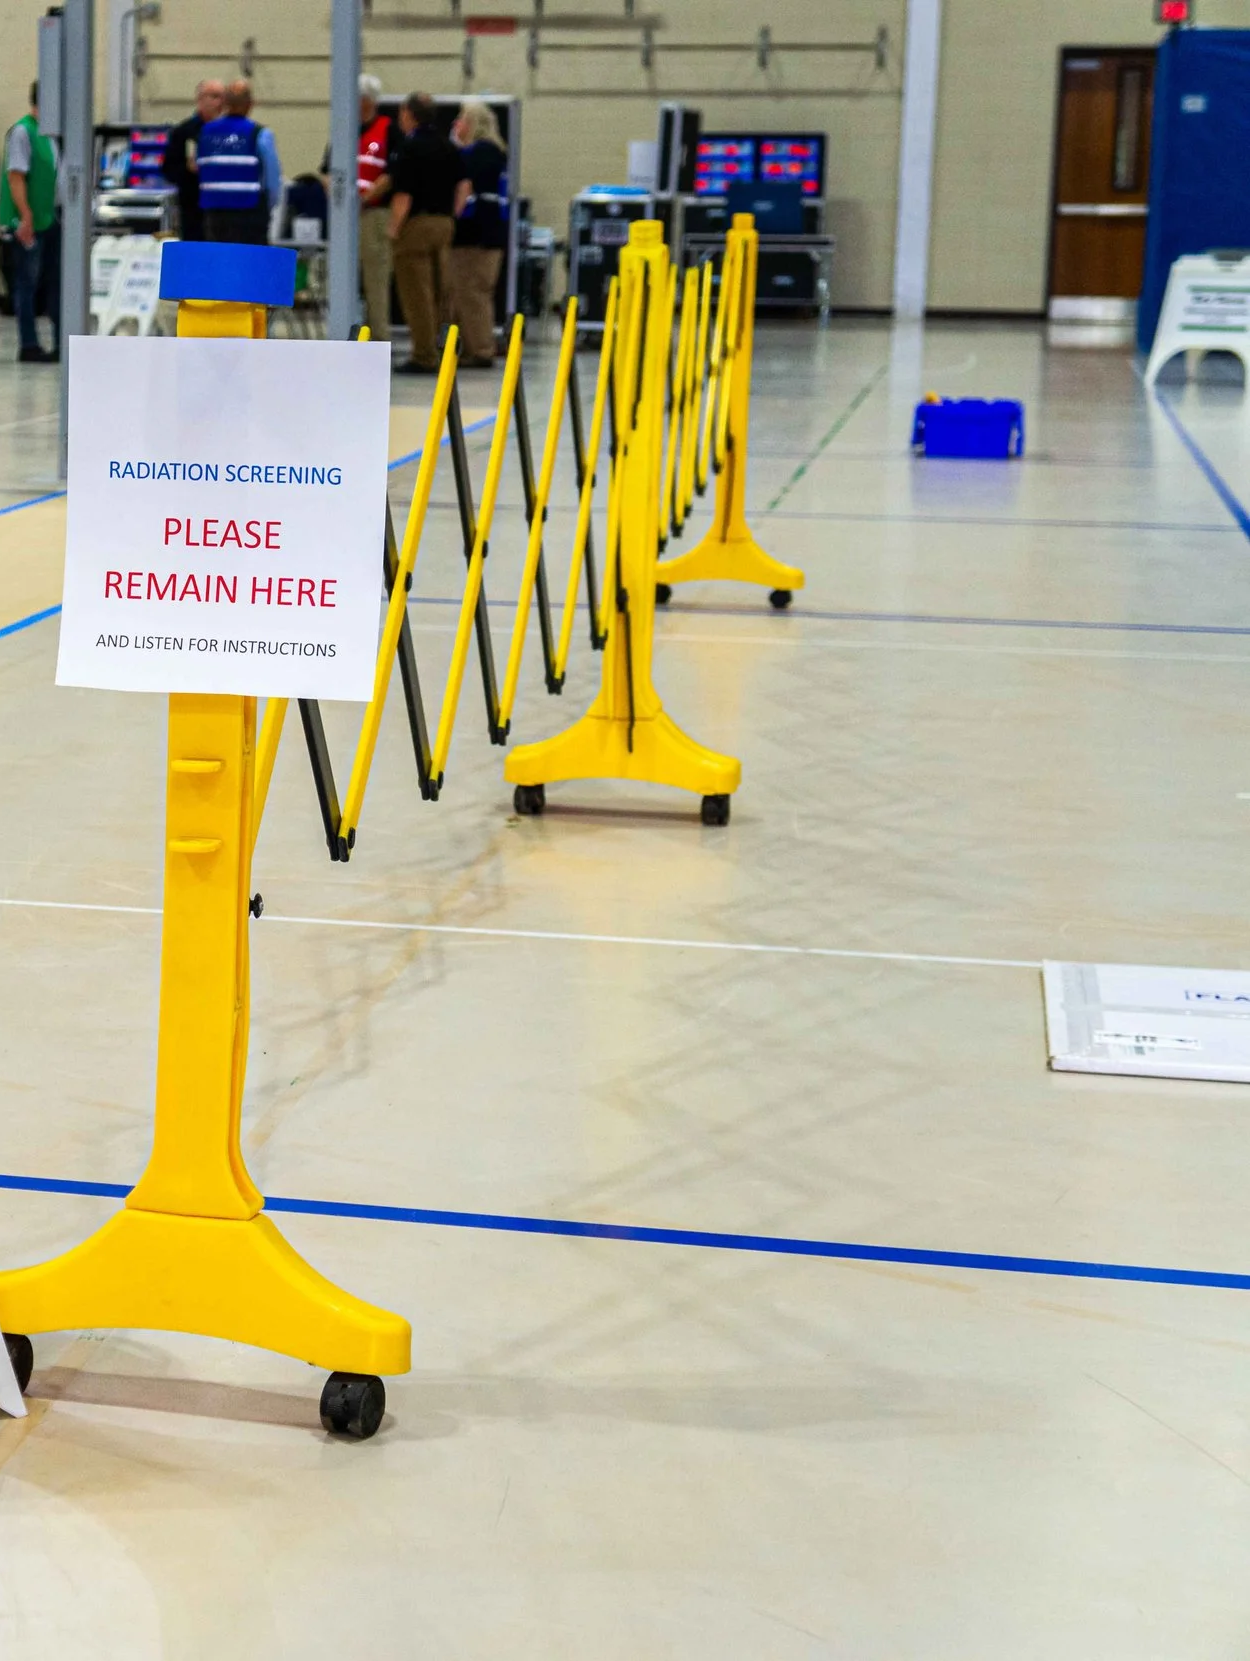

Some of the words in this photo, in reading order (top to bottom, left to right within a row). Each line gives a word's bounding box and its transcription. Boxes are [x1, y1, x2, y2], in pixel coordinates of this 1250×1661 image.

[109, 460, 219, 482] RADIATION
[225, 464, 342, 486] SCREENING
[164, 517, 282, 550] PLEASE
[104, 570, 238, 604] REMAIN
[250, 576, 338, 608] HERE
[95, 633, 130, 649] AND
[134, 635, 184, 651] LISTEN
[188, 637, 219, 653] FOR
[223, 639, 337, 658] INSTRUCTIONS
